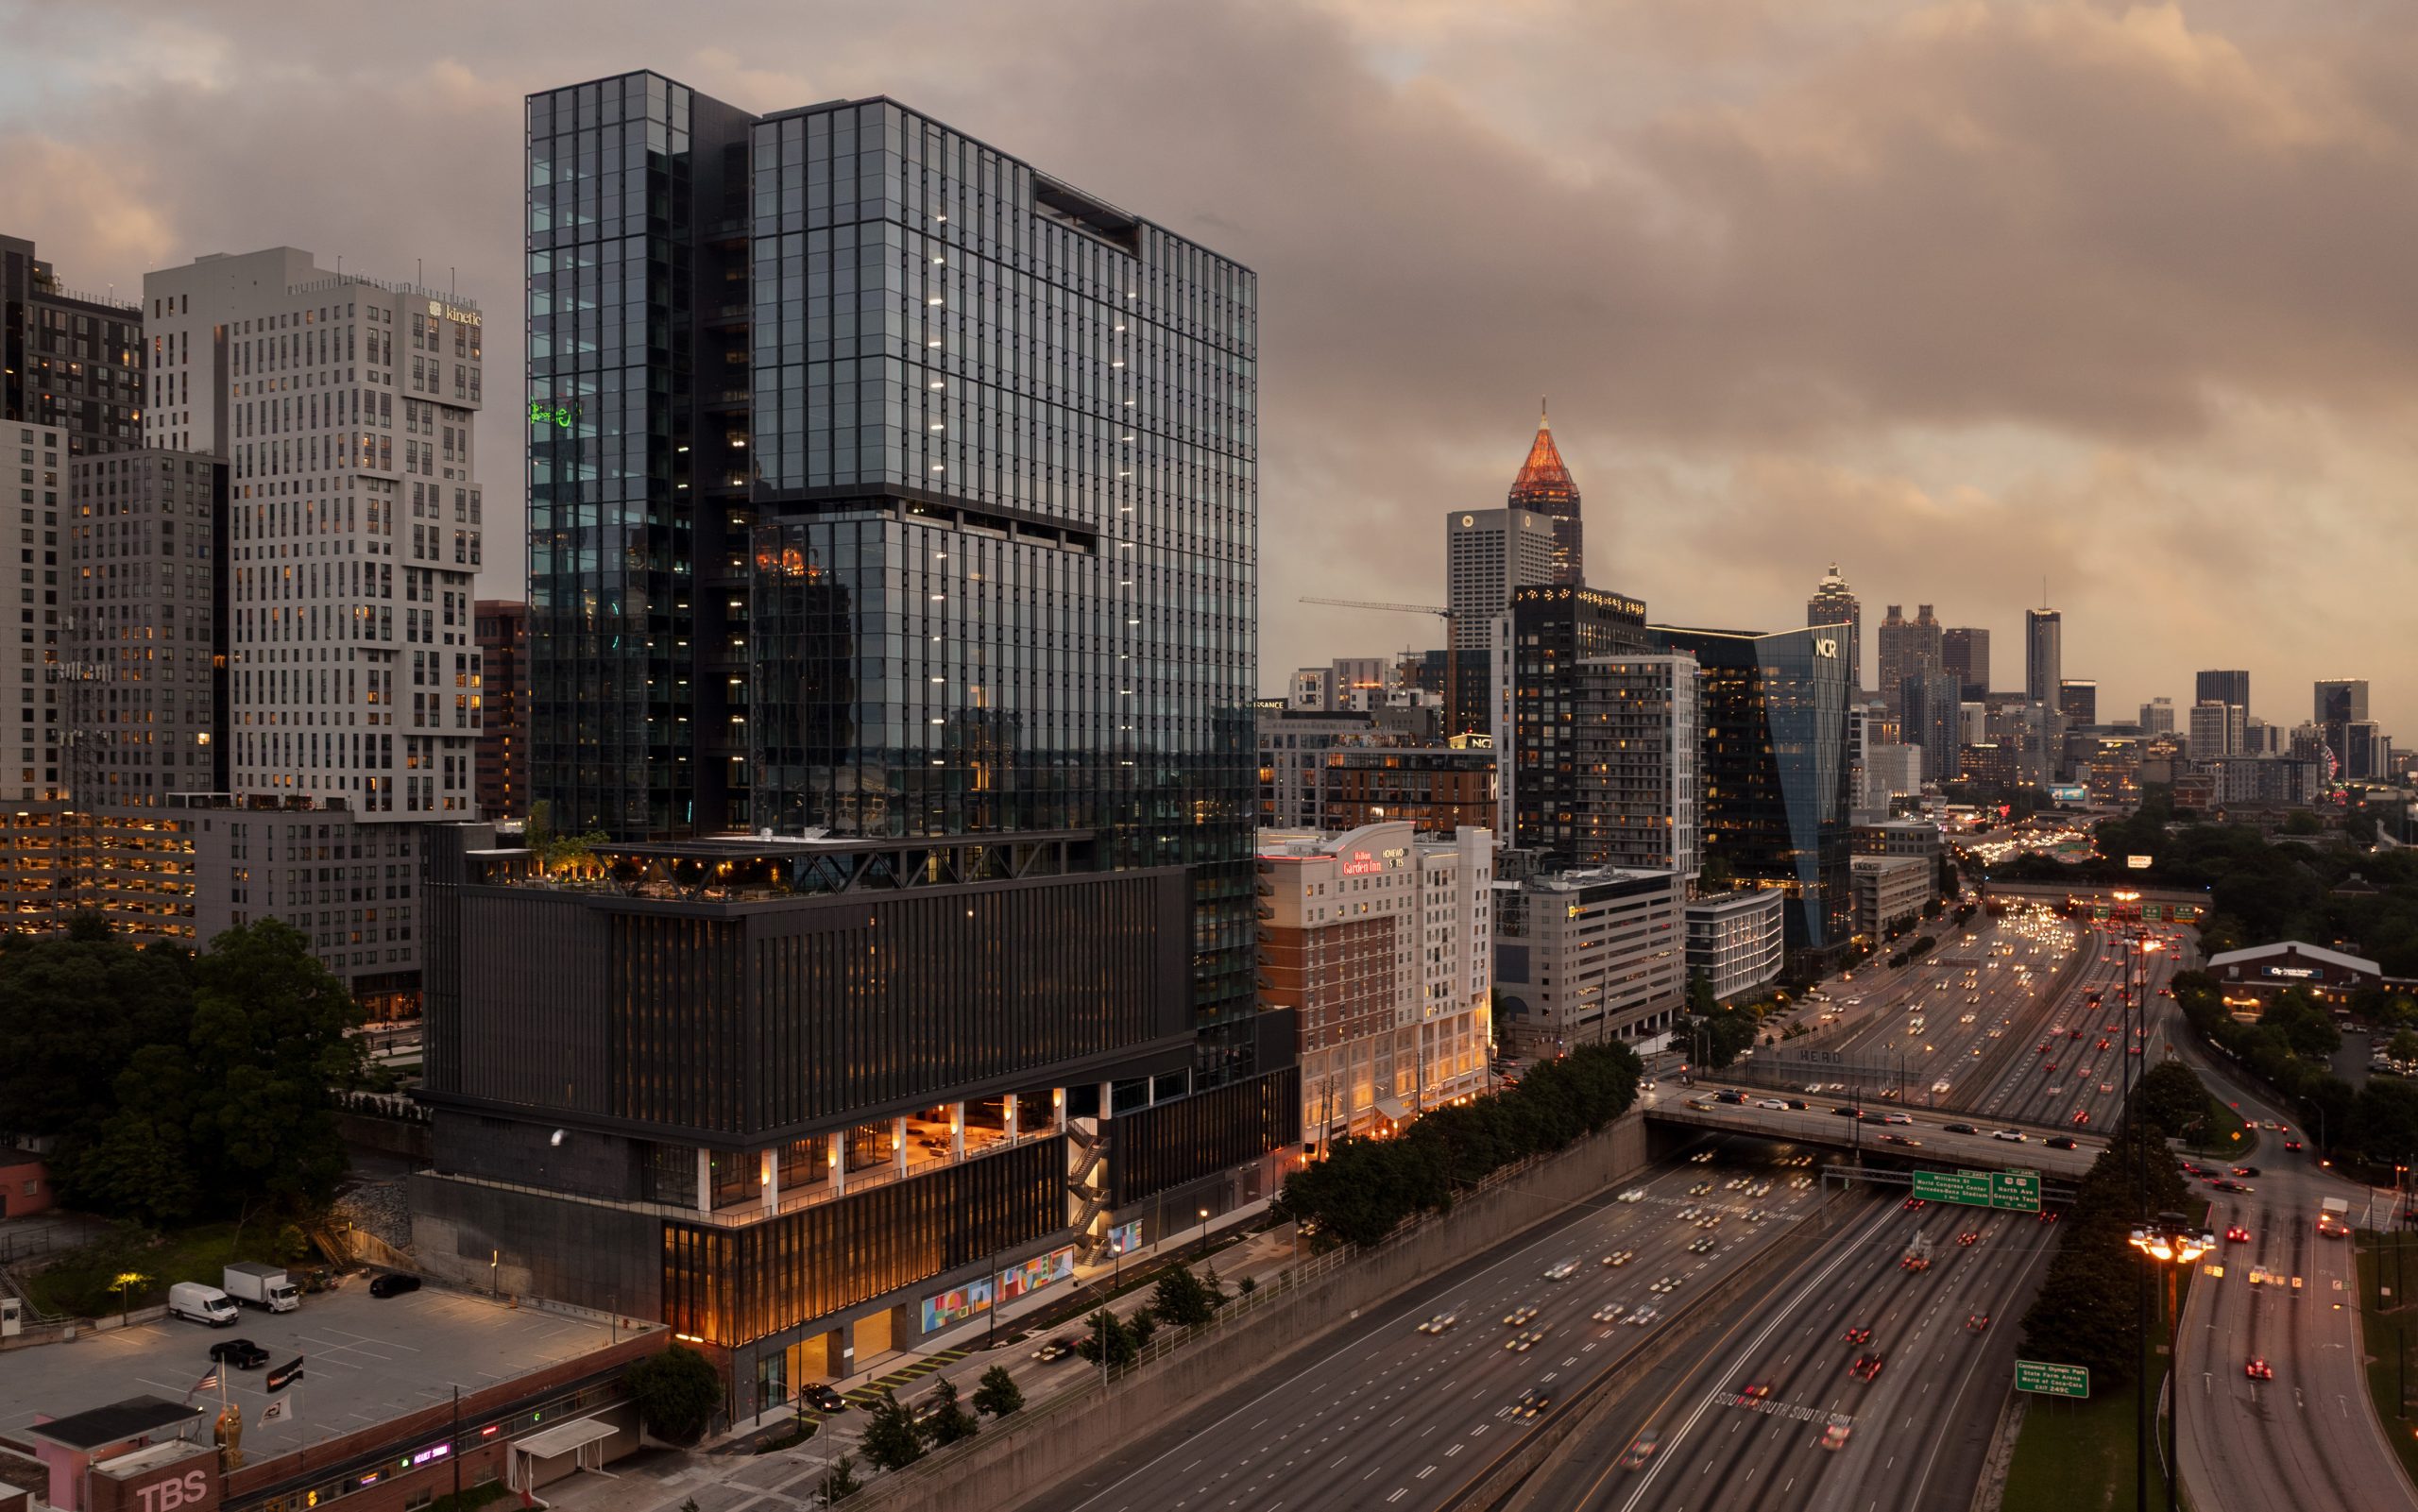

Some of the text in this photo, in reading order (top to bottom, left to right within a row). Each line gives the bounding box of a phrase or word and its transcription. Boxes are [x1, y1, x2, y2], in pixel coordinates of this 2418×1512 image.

[447, 304, 482, 327] kinetic
[1815, 637, 1836, 658] NCR
[1354, 851, 1371, 860] Hilton
[1343, 860, 1382, 875] Garden Inn
[1916, 1185, 1988, 1198] Mercedes-Benz Stadium
[1993, 1193, 2019, 1201] Georgia
[2051, 1379, 2083, 1388] Coca-Cola
[1714, 1391, 1751, 1409] SOUH
[1789, 1405, 1829, 1423] SOUTH
[136, 1470, 207, 1512] TBS
